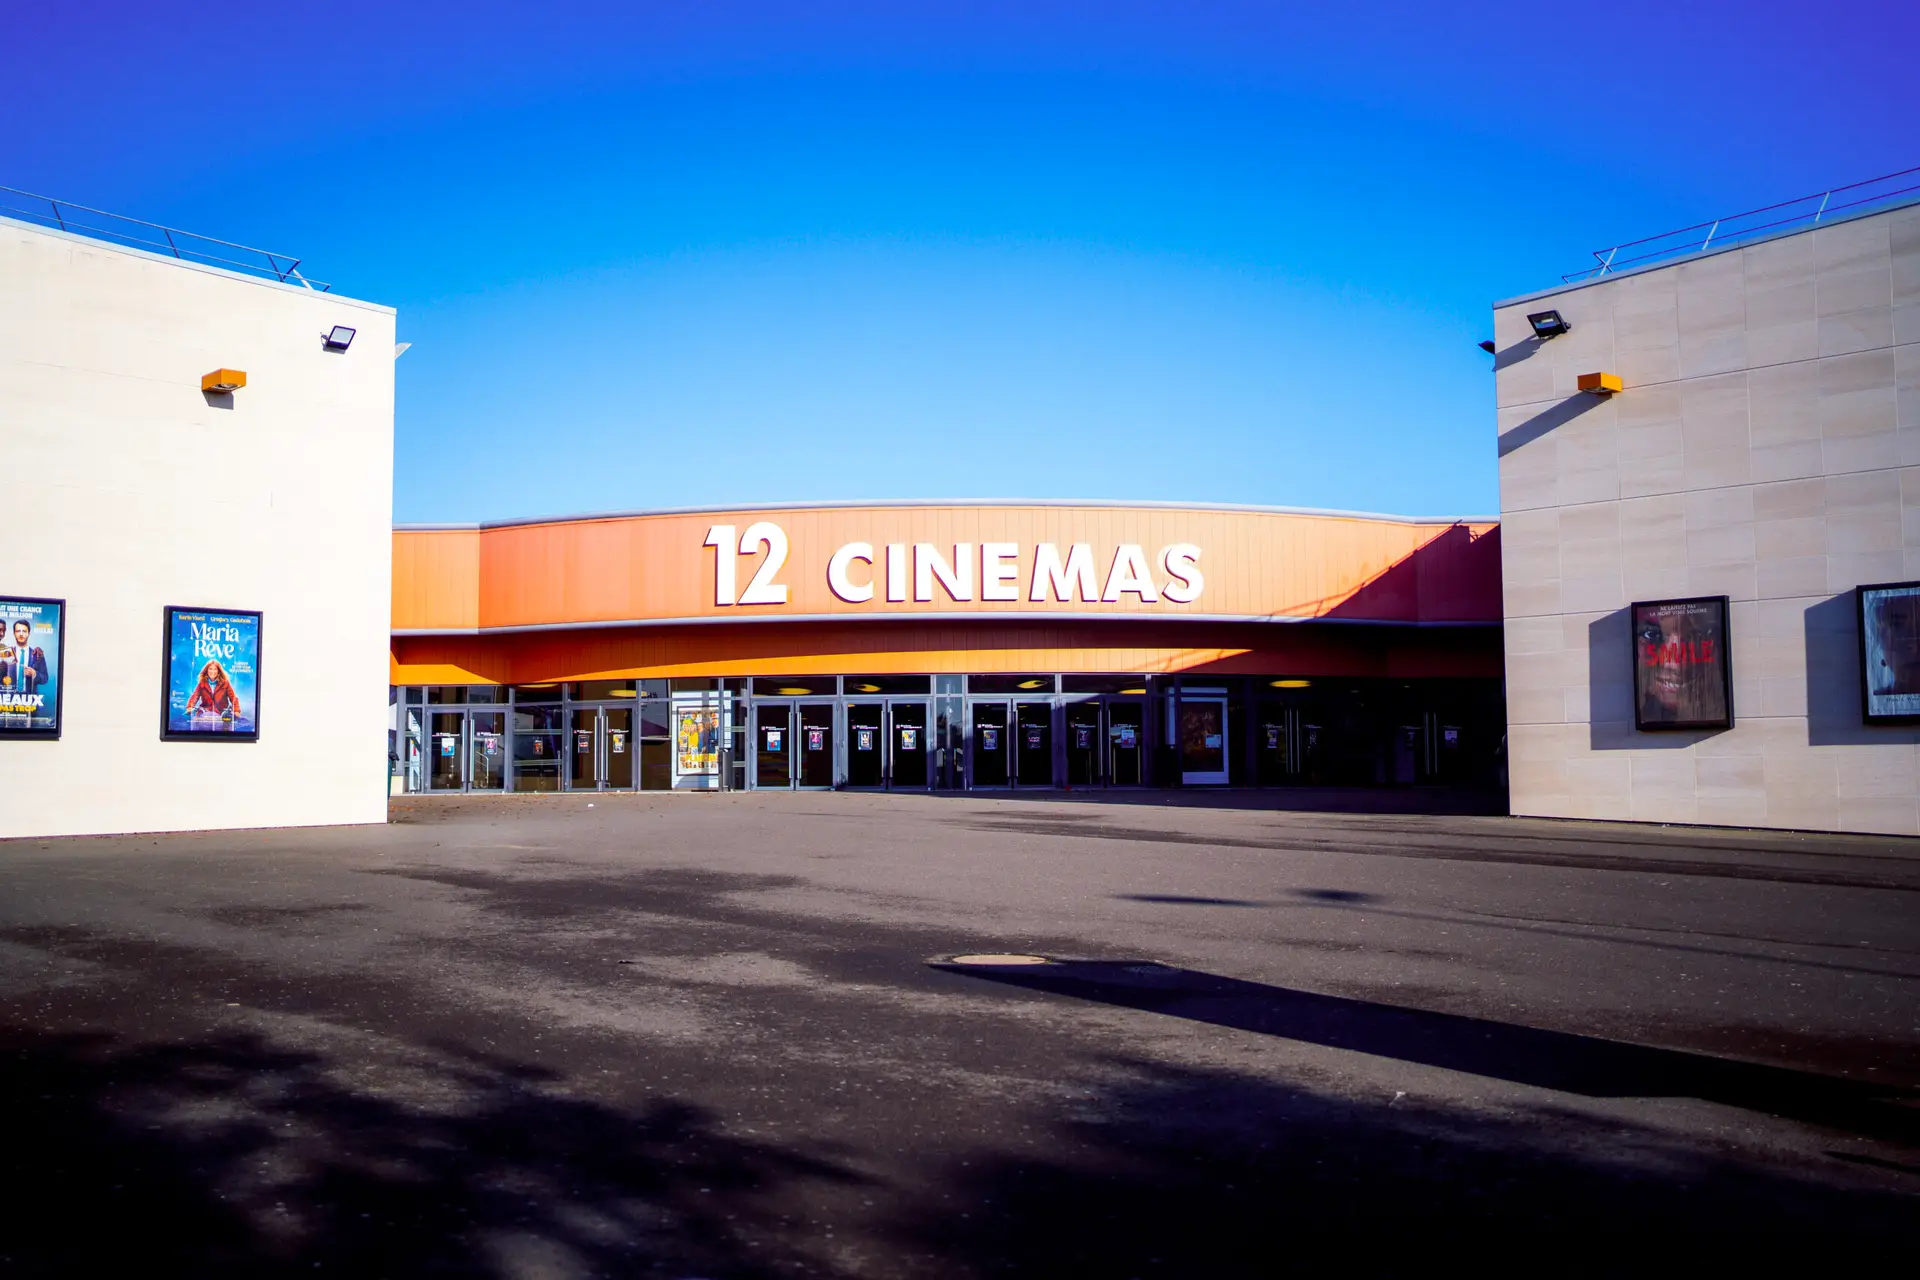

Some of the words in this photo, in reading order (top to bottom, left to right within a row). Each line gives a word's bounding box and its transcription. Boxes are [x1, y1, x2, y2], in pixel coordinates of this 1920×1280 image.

[703, 521, 789, 607] 12
[827, 542, 1205, 604] CINEMAS
[190, 622, 239, 642] Maria
[195, 639, 235, 660] Rêve
[1647, 640, 1715, 666] SMILE
